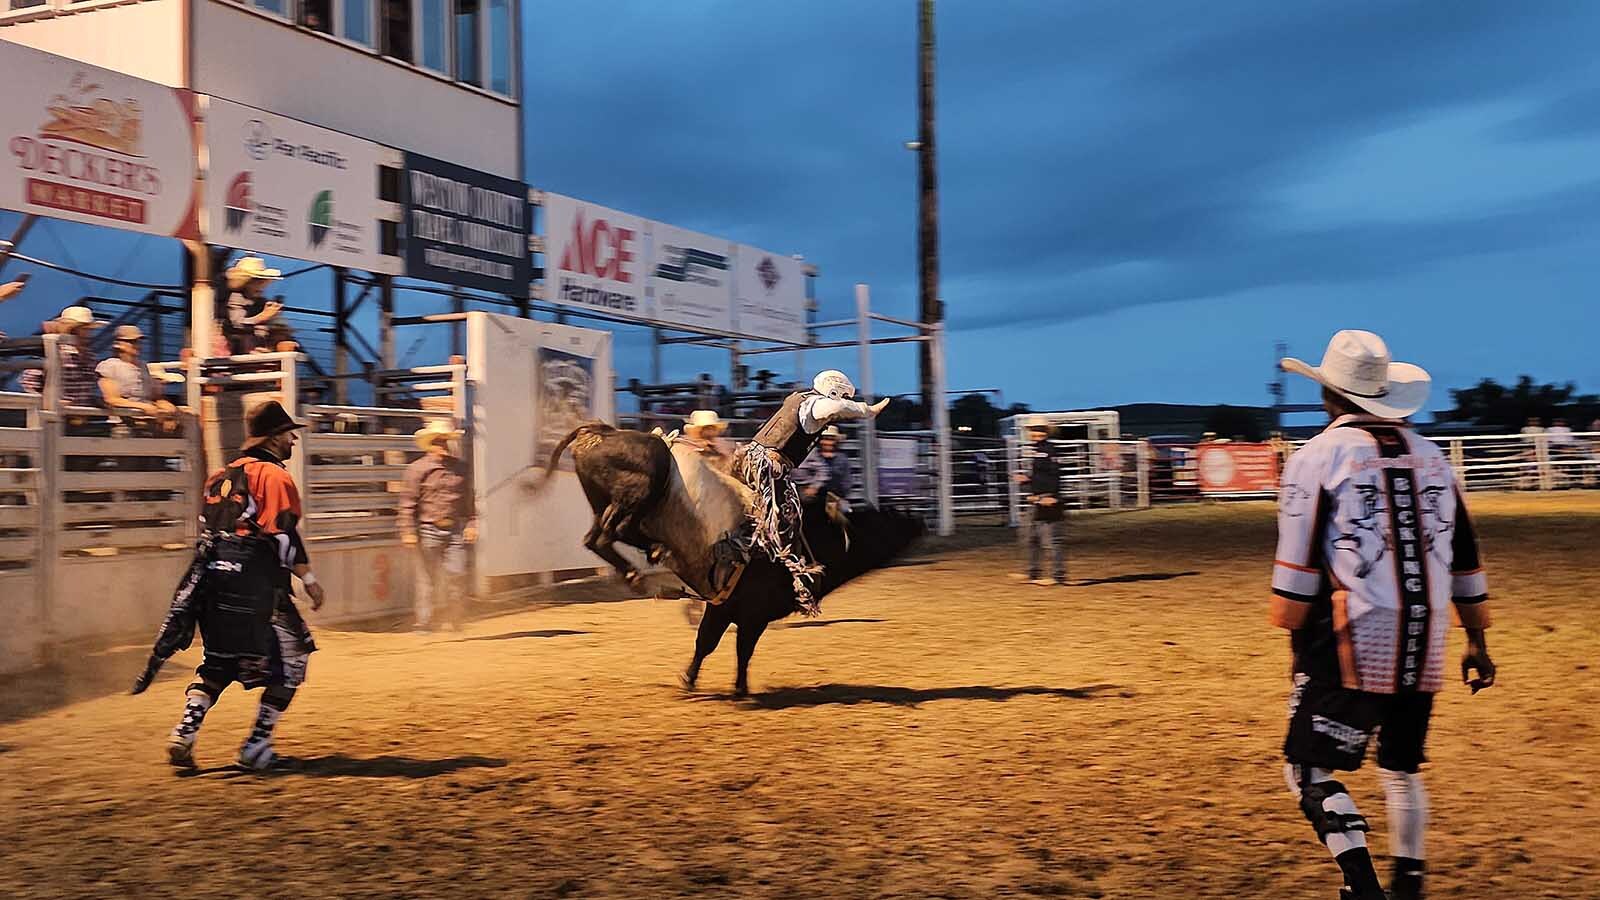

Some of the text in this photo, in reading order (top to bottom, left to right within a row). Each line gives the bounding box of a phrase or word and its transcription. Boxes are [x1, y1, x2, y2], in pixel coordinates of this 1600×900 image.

[557, 206, 636, 284] ACE
[559, 276, 637, 312] Hardware
[1393, 477, 1422, 592] BUCKING
